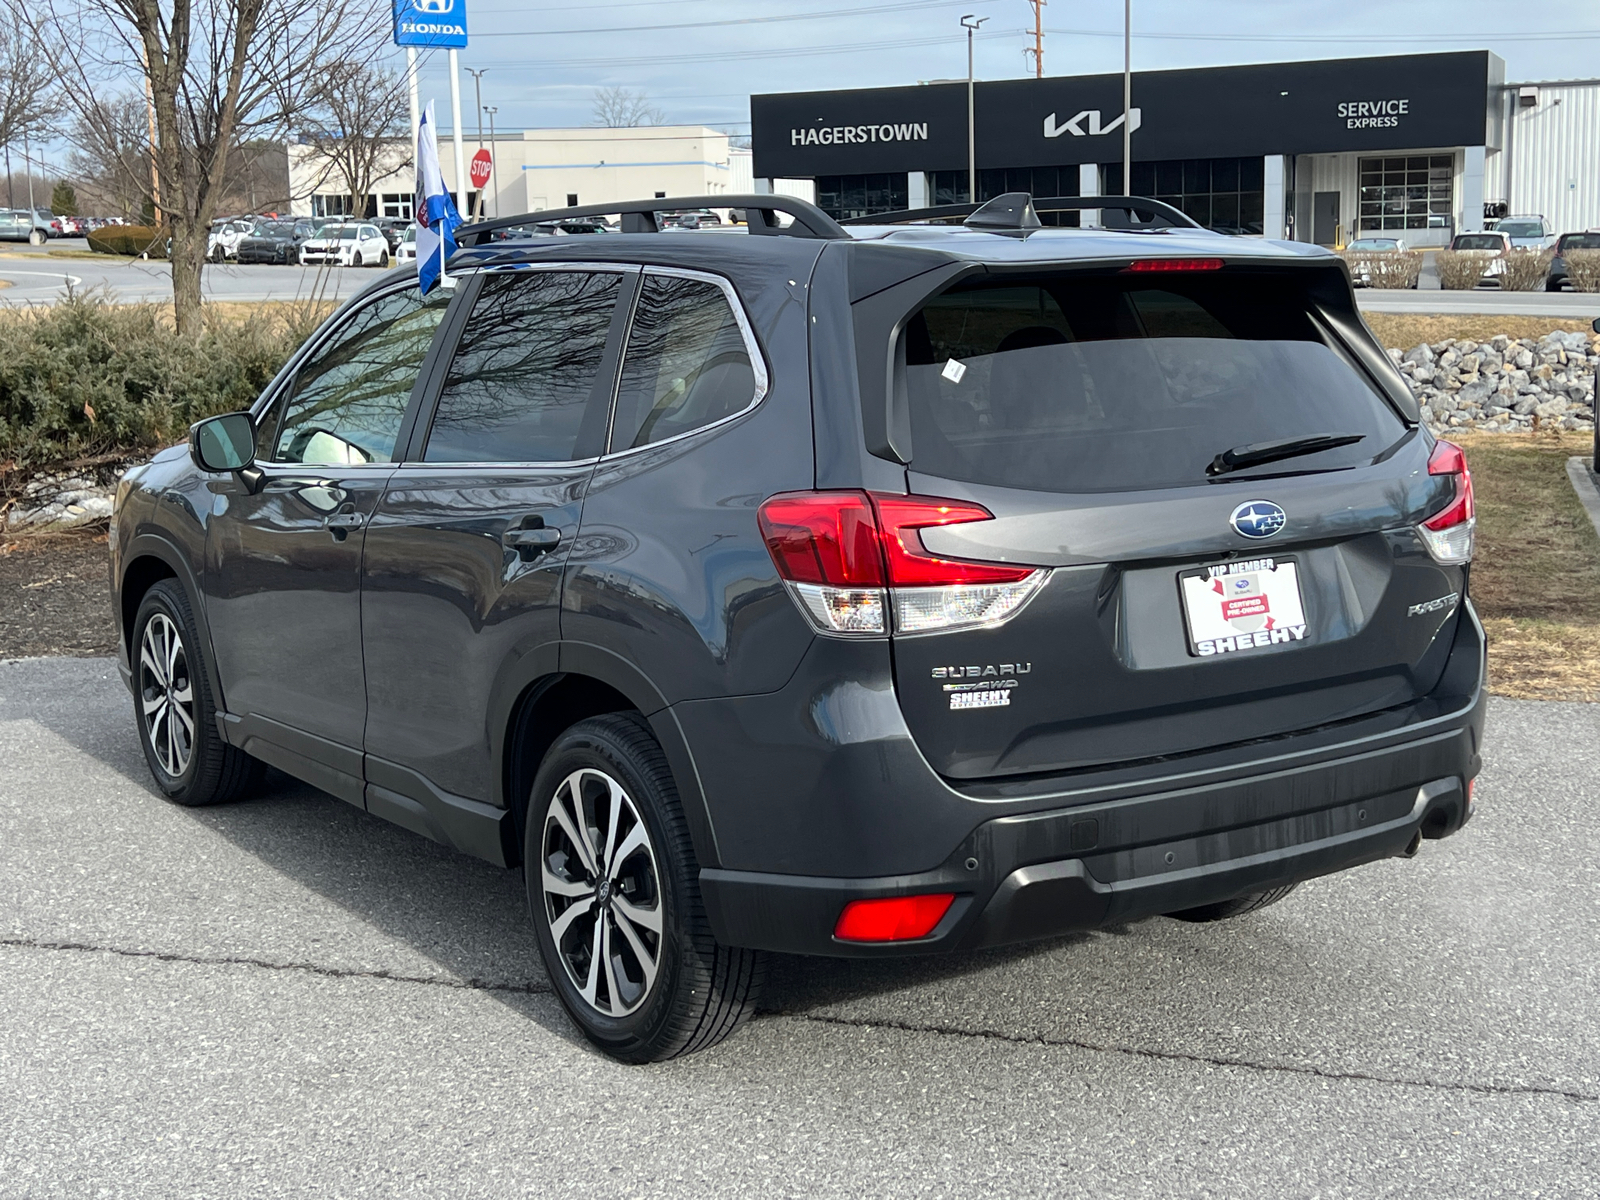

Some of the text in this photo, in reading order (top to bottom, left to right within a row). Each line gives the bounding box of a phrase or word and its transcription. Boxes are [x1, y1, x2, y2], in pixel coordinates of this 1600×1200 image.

[401, 23, 466, 36] HONDA
[1337, 99, 1409, 118] SERVICE
[1347, 116, 1398, 129] EXPRESS
[791, 122, 928, 146] HAGERSTOWN
[471, 159, 492, 178] STOP
[1208, 558, 1274, 577] VIP MEMBER
[1226, 604, 1266, 616] PRE-OWNED
[1228, 598, 1262, 609] CERTIFIED
[1197, 625, 1307, 657] SHEEHY
[931, 662, 1032, 679] SUBARU
[950, 689, 1011, 703] SHEEHY
